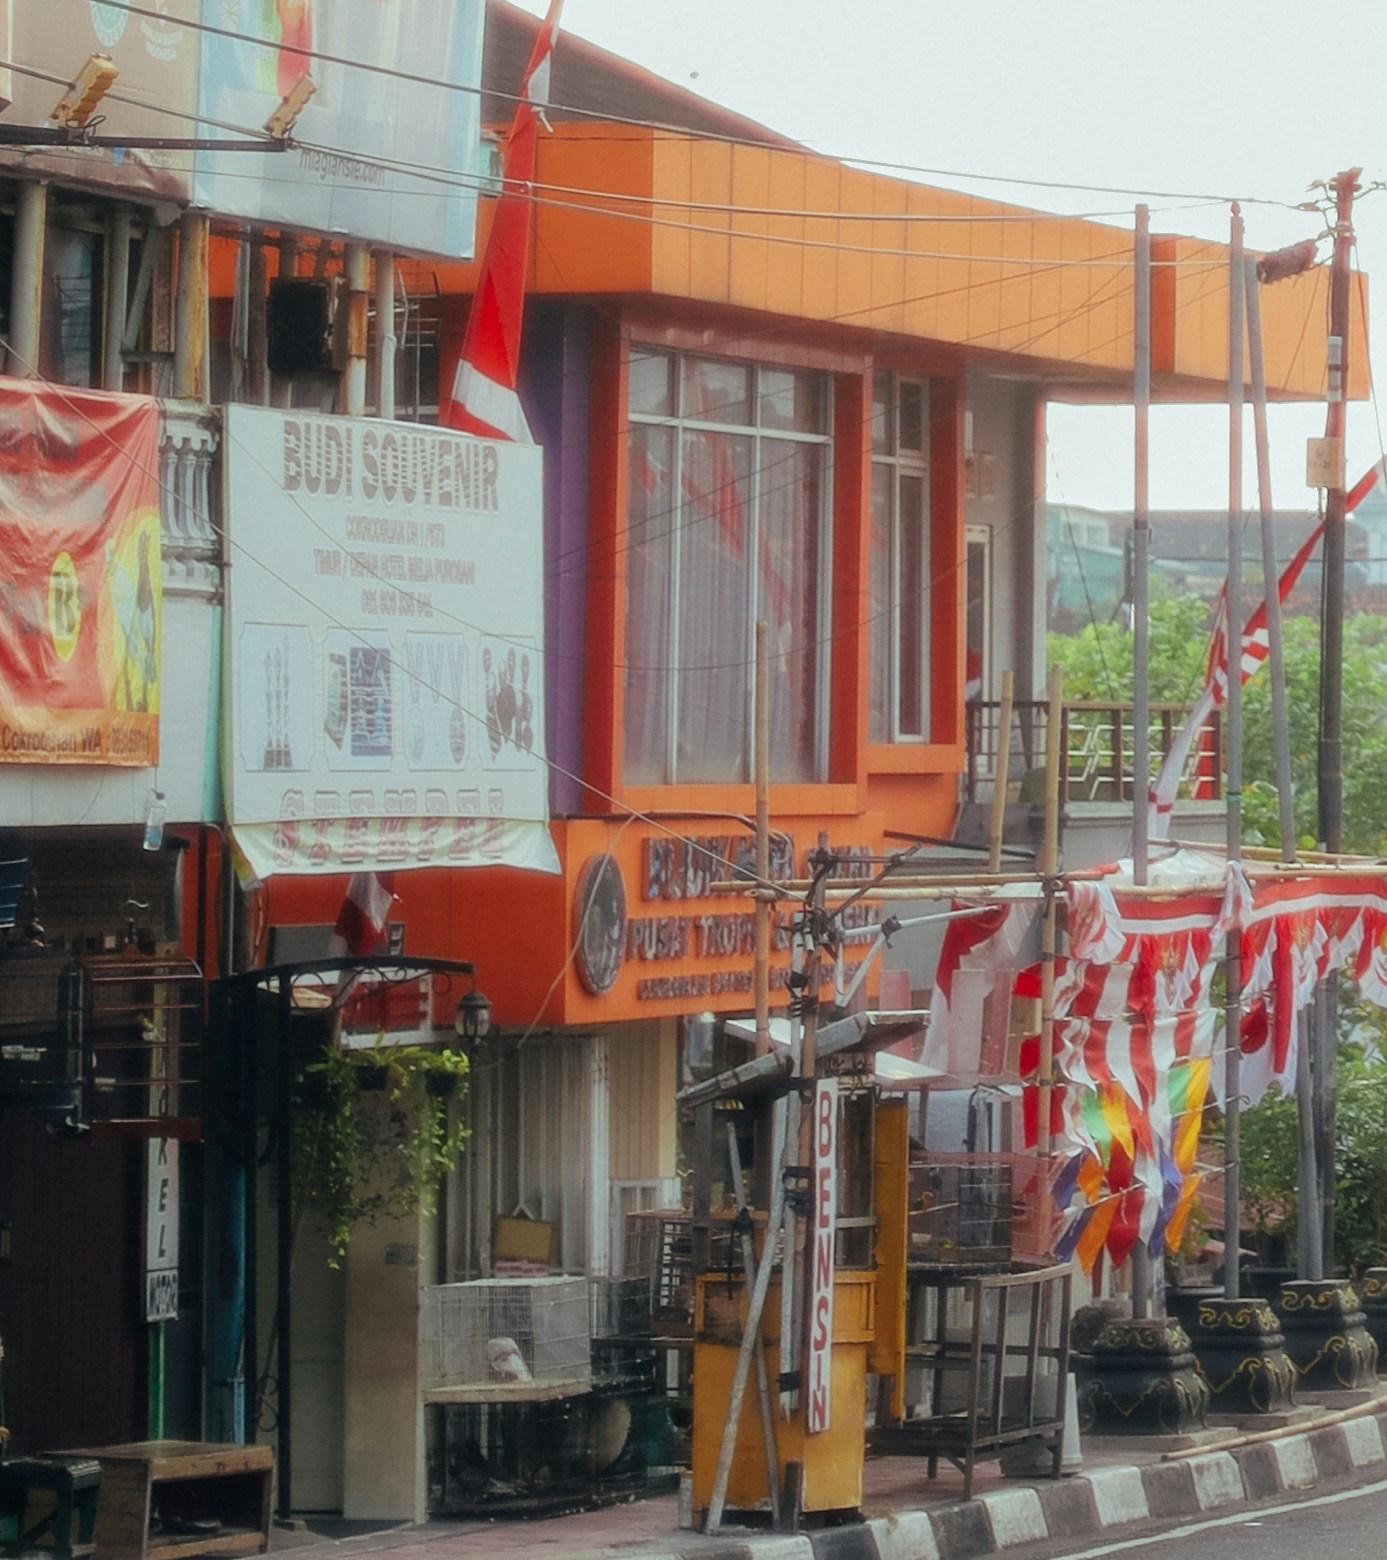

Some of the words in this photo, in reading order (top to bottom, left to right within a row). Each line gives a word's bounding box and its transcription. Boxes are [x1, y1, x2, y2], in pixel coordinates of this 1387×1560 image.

[283, 420, 353, 497] BUDI
[361, 429, 500, 513] SOUVENIR
[812, 1089, 832, 1430] BENSIN
